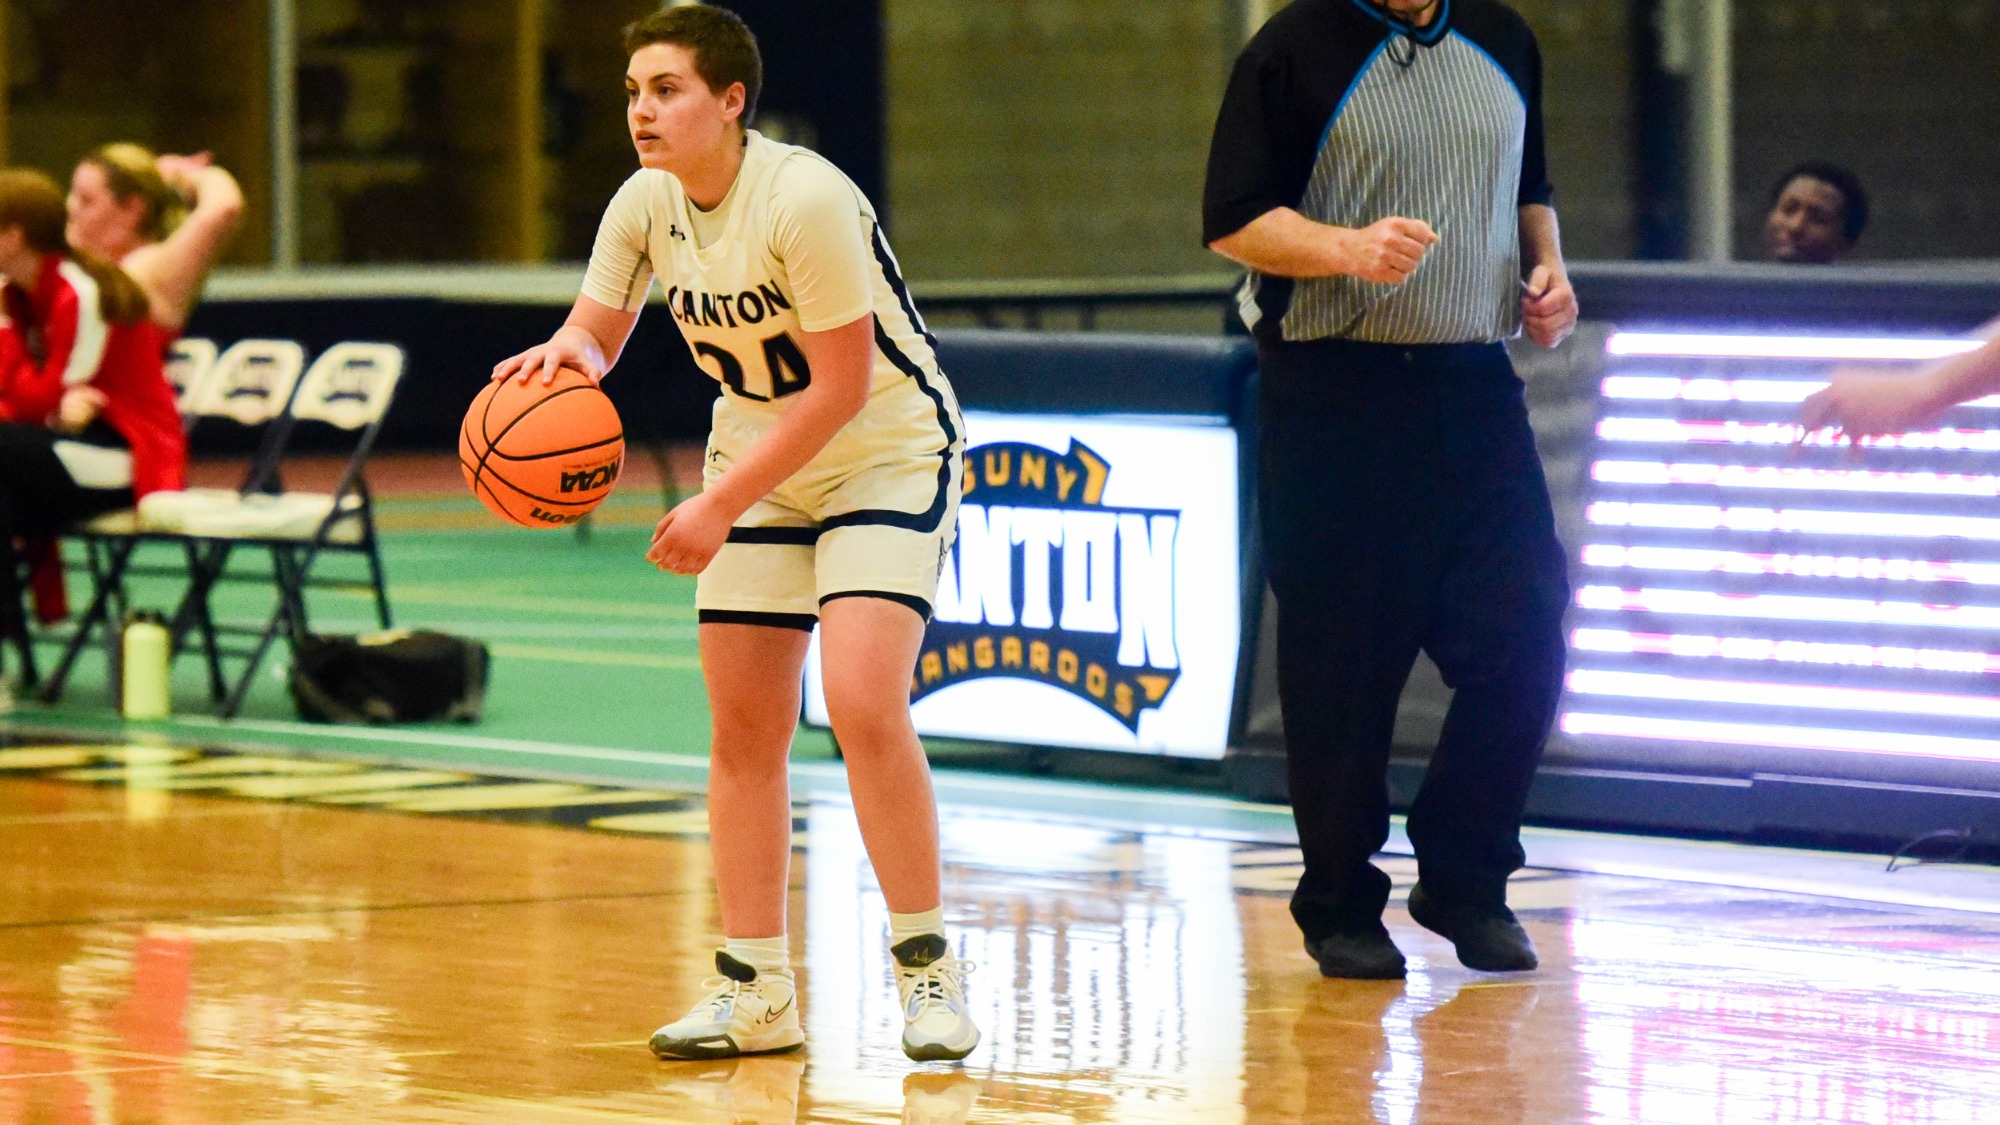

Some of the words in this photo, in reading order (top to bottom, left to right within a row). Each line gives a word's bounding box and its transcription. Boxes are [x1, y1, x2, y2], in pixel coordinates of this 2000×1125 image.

[668, 279, 792, 328] CANTON
[693, 330, 811, 402] 24
[560, 456, 621, 494] NCAA
[934, 503, 1180, 670] NTON
[910, 635, 1134, 718] ANGAROOS
